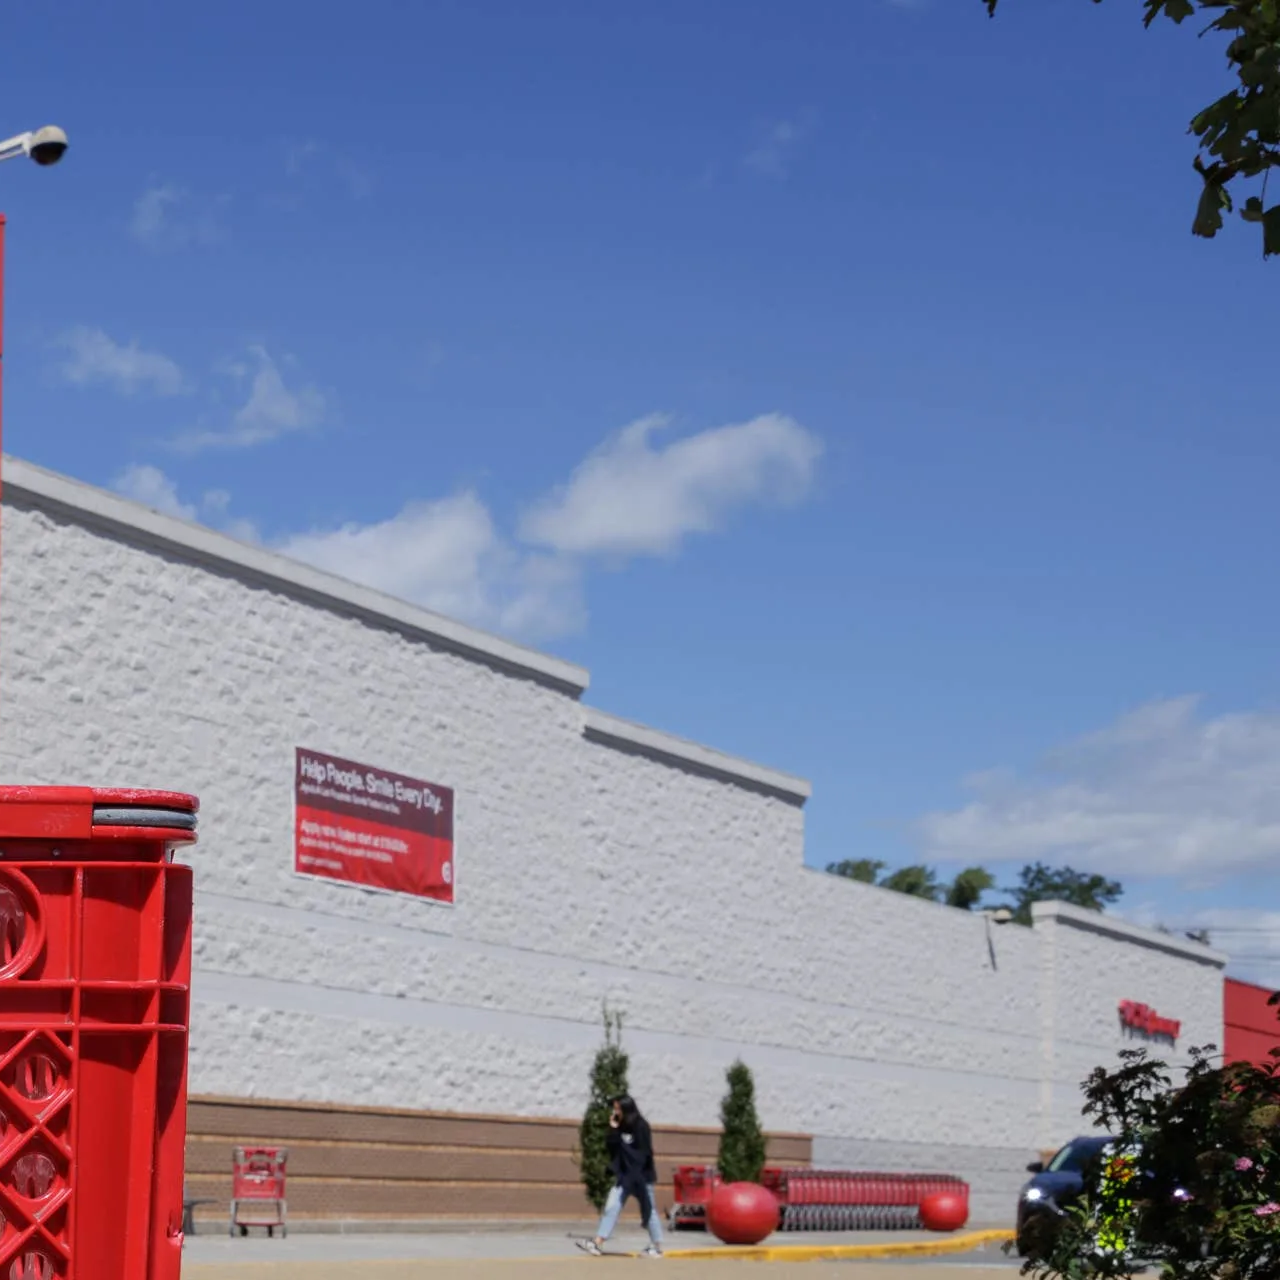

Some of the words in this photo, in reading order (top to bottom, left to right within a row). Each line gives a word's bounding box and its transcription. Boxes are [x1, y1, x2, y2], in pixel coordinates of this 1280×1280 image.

[301, 757, 326, 783] Help
[327, 762, 364, 790] People.
[365, 773, 394, 799] Smile
[394, 781, 421, 809] Every
[422, 788, 444, 815] Day.
